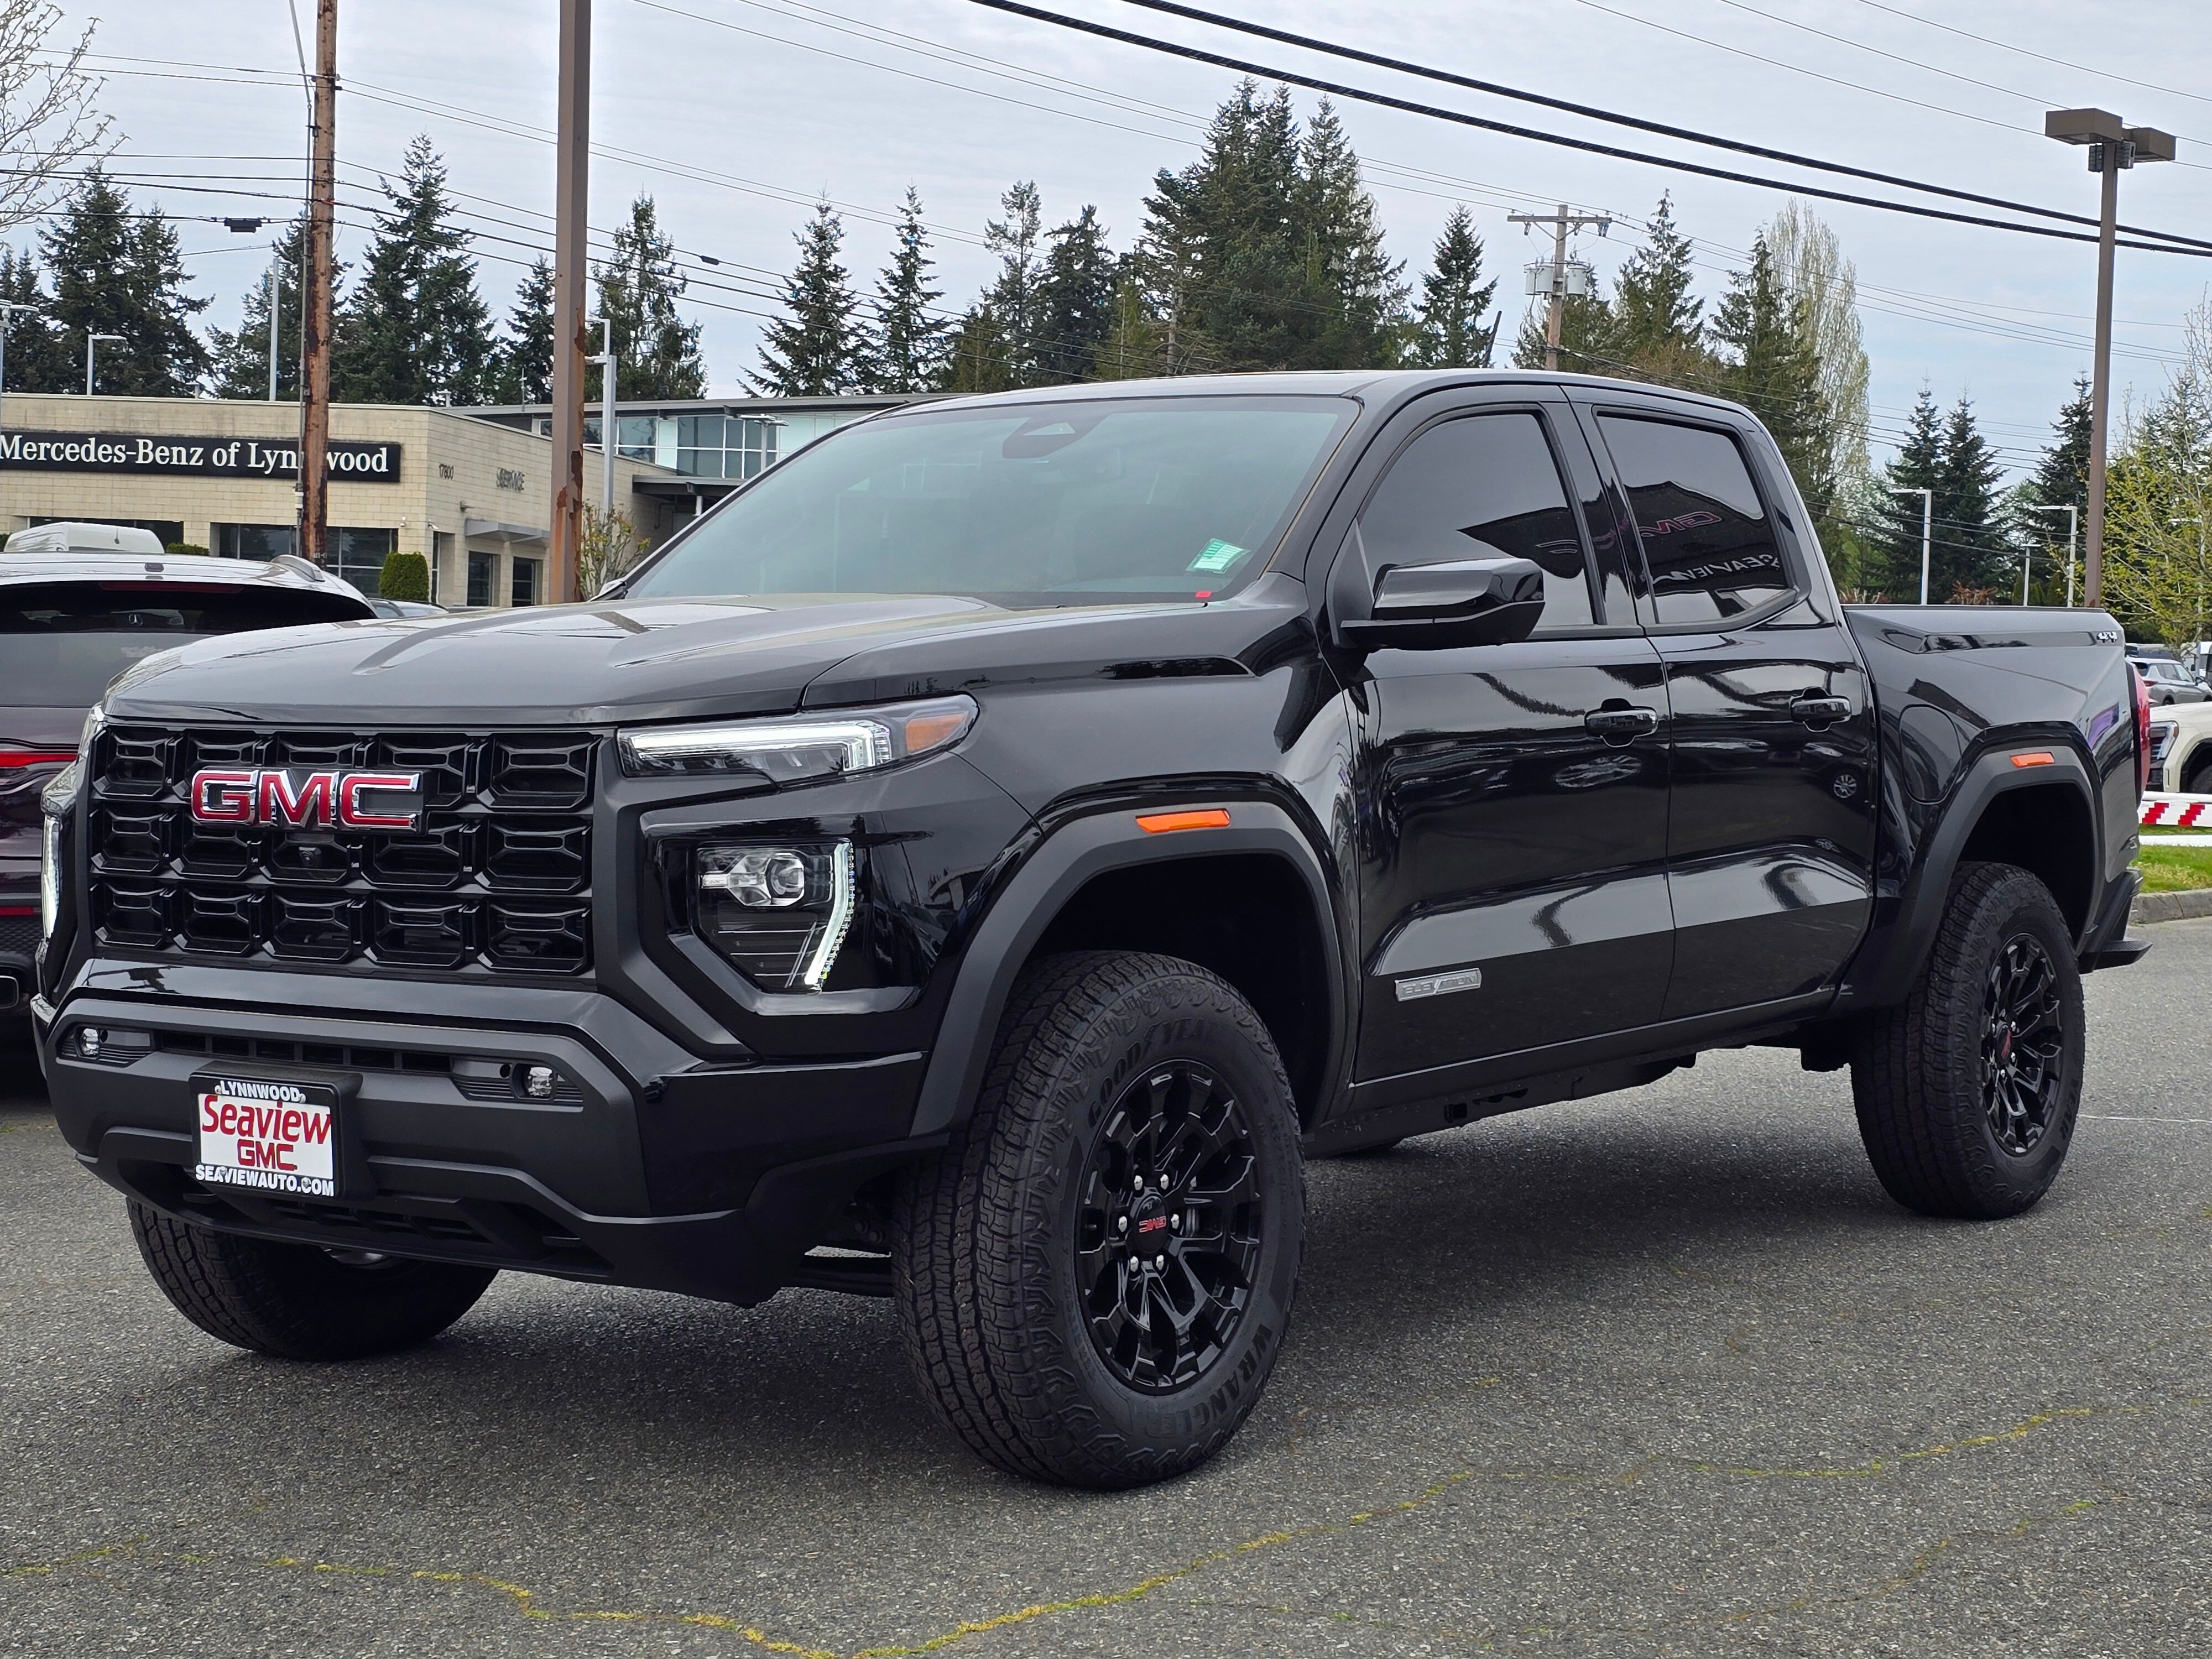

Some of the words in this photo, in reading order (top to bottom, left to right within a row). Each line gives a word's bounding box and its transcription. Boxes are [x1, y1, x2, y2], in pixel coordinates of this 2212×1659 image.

[0, 435, 204, 466] Mercedes-Benz
[212, 442, 241, 467] of
[247, 442, 389, 474] Lynwood
[496, 468, 525, 492] SERVICE
[191, 769, 420, 831] GMC
[1088, 1017, 1221, 1129] GOODYEA
[220, 1080, 301, 1103] LYNNWOOD
[201, 1094, 331, 1145] Seaview
[237, 1139, 298, 1171] GMC
[195, 1164, 335, 1197] SEAVIEWAUTO.COM
